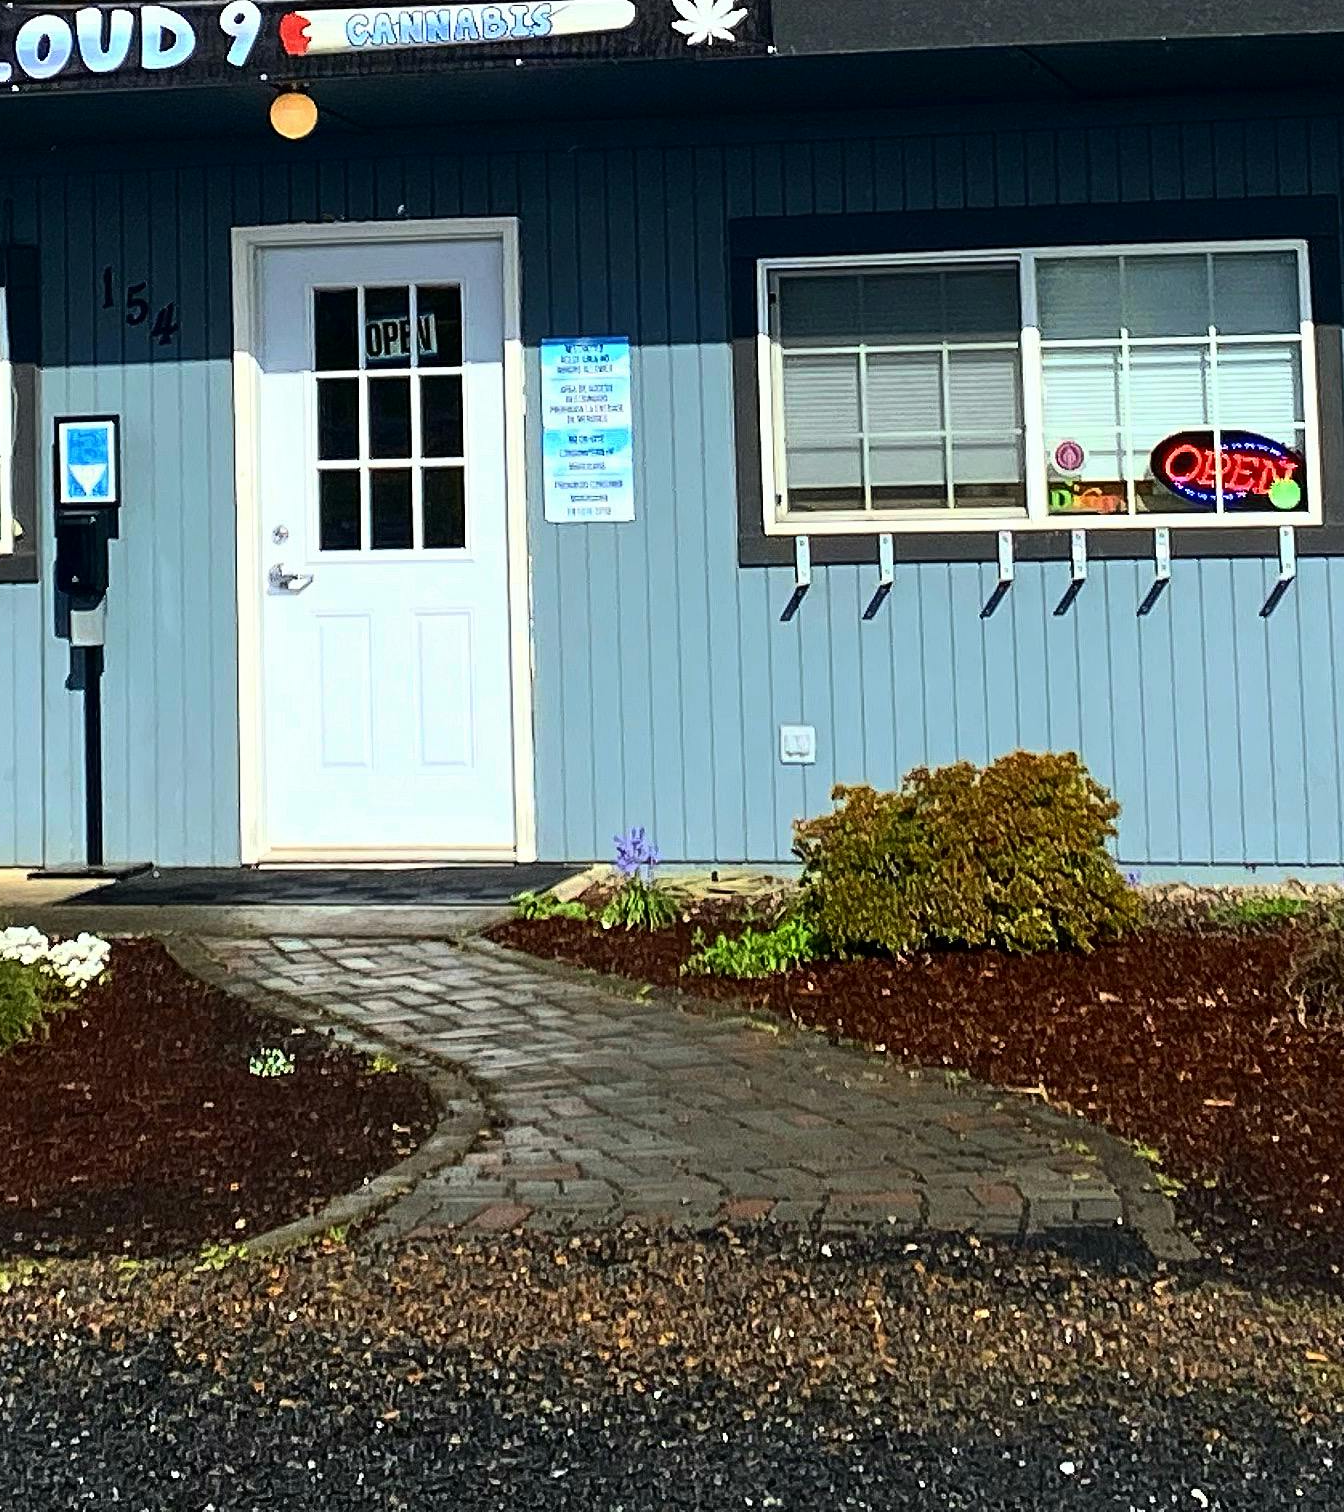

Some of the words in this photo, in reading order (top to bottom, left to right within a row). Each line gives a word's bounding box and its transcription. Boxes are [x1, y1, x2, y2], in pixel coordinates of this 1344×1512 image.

[344, 1, 554, 47] CANNABIS
[102, 265, 180, 346] 154
[366, 316, 432, 357] OPEN
[1165, 444, 1298, 494] OPEN
